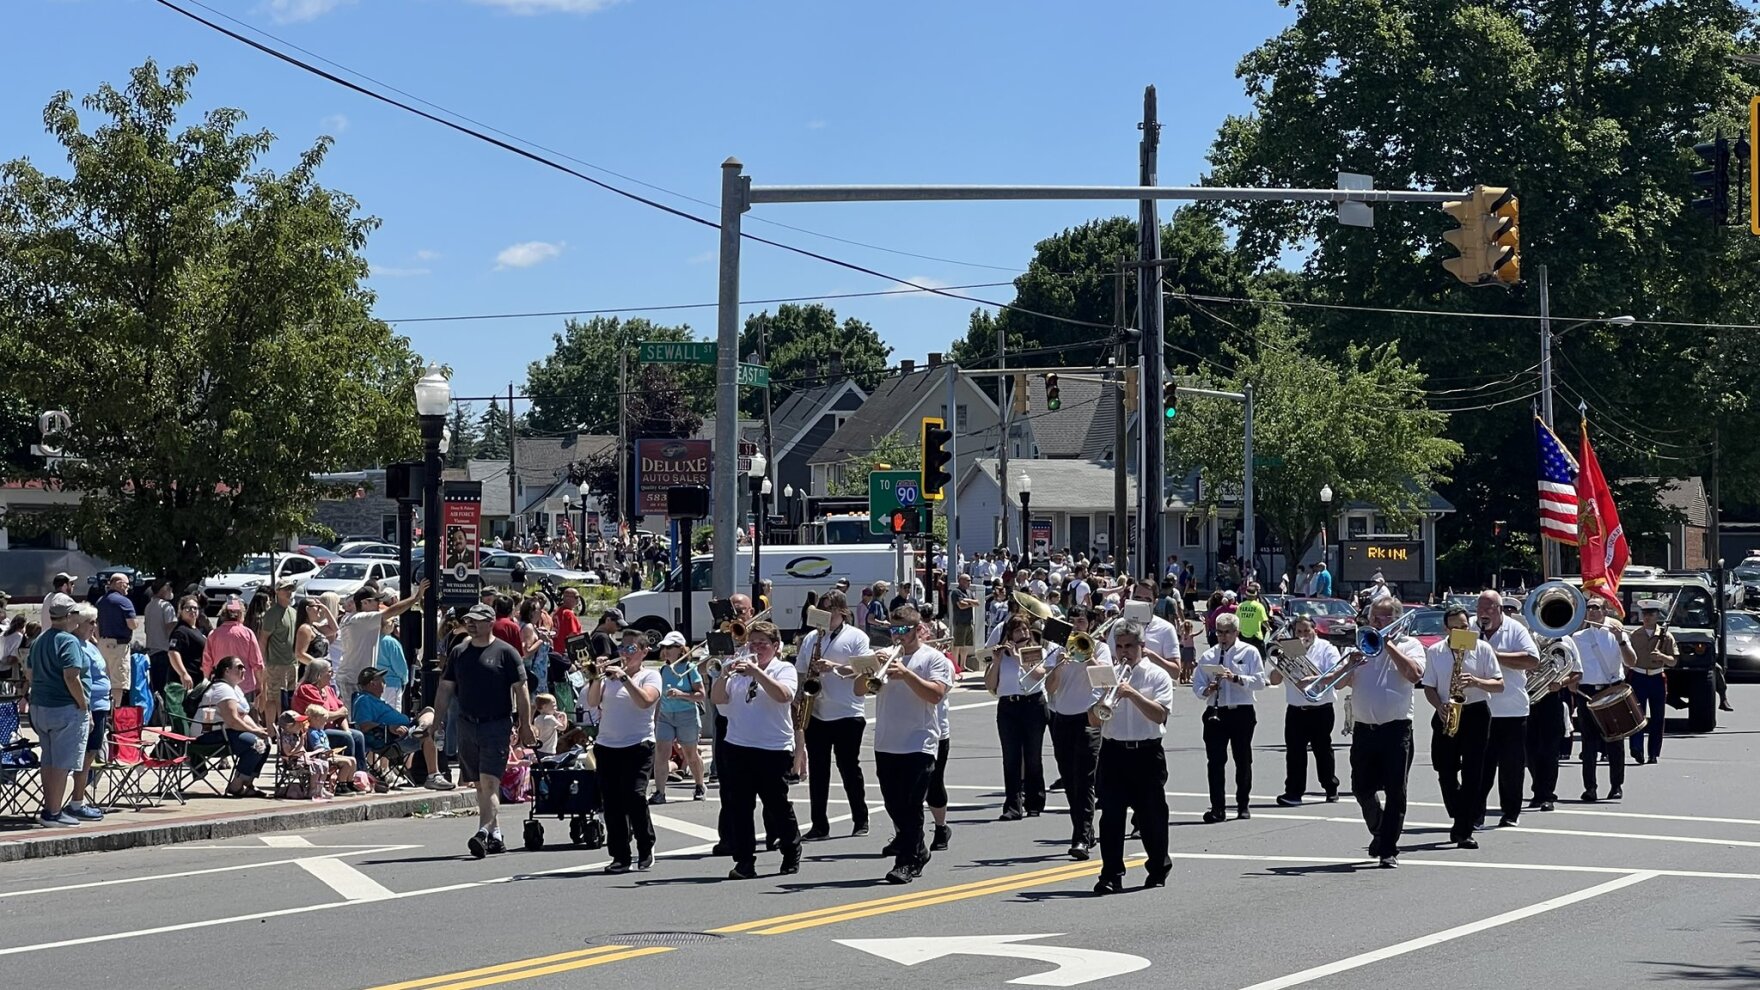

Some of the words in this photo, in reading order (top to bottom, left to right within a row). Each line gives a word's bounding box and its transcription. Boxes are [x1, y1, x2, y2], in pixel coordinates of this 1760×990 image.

[647, 345, 700, 360] SEWALL
[703, 345, 712, 353] ST
[737, 366, 758, 383] EAST
[642, 457, 707, 472] DELUXE
[642, 473, 670, 482] AUTO
[672, 473, 706, 482] SALES
[880, 480, 890, 490] TO
[646, 493, 668, 501] 583
[897, 487, 915, 502] 90
